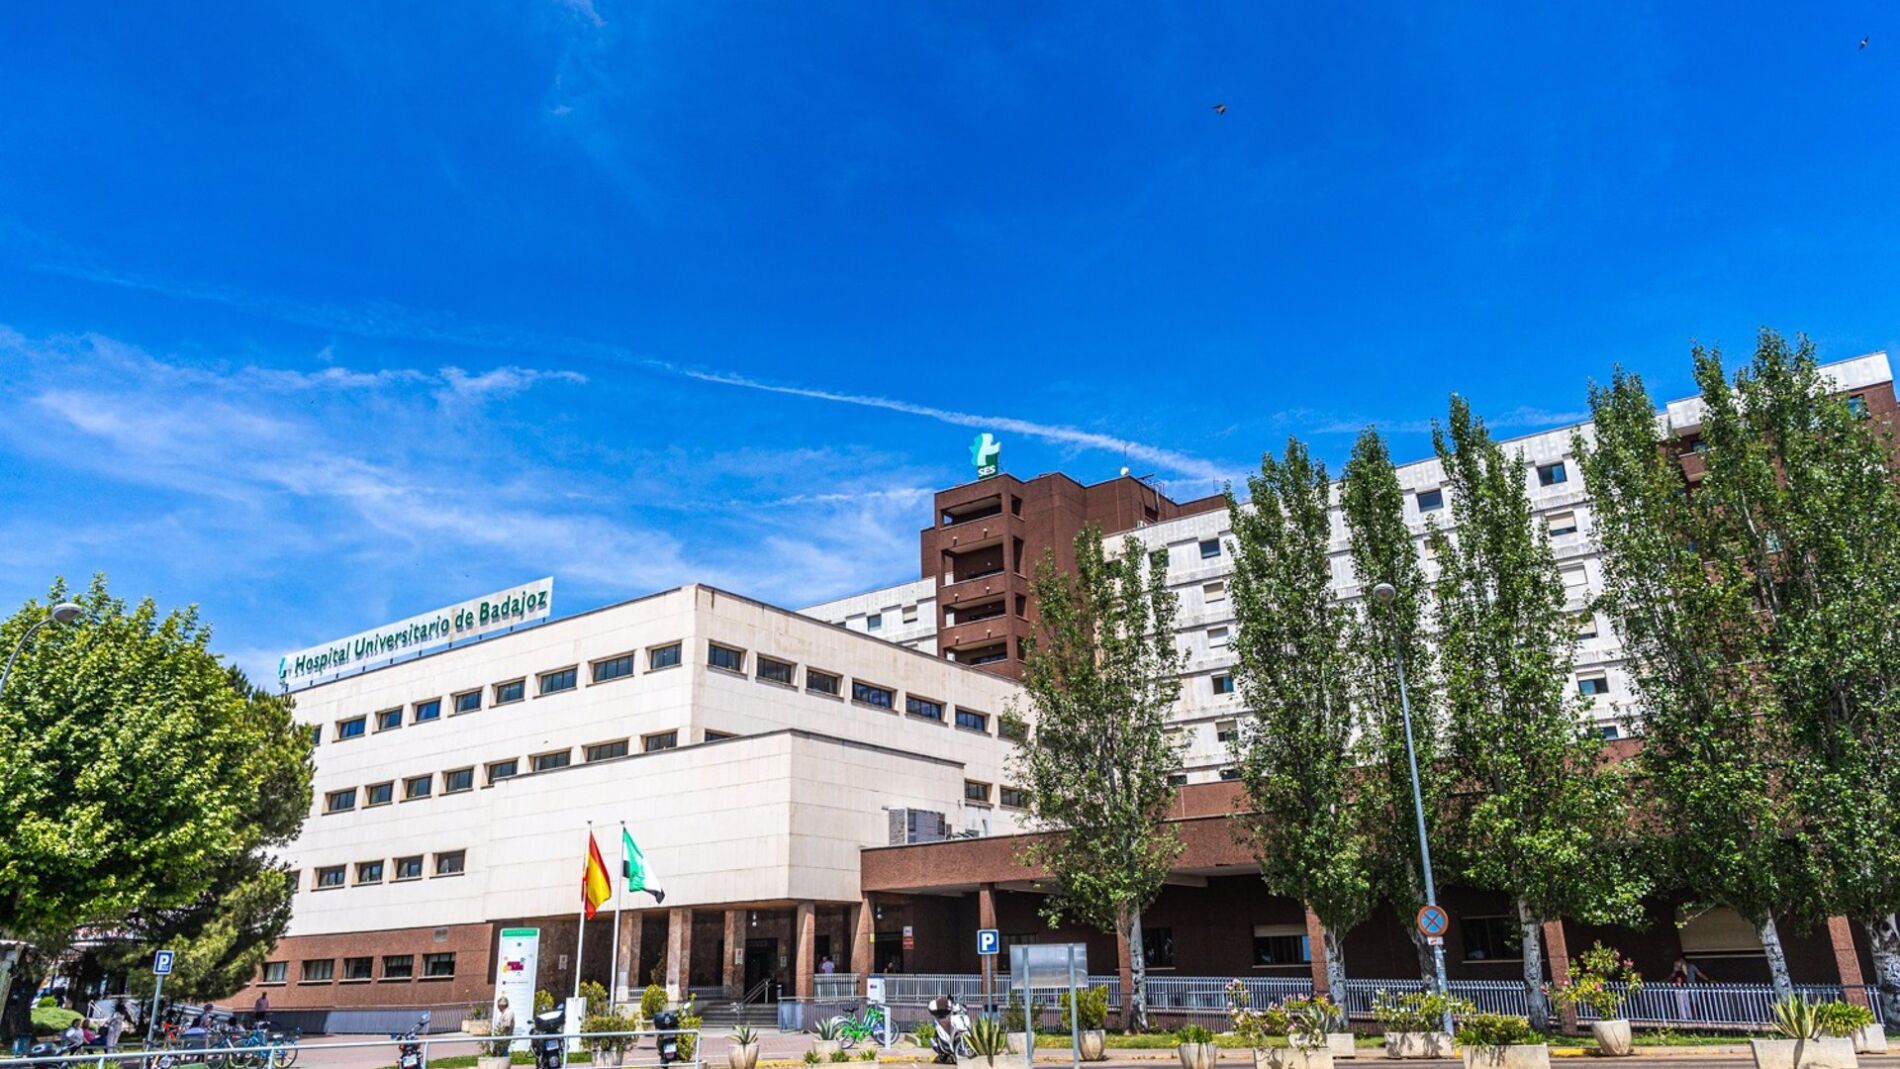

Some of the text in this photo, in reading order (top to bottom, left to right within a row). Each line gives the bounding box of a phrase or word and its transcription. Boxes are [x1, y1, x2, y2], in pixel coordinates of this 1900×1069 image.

[978, 465, 996, 477] SES
[294, 590, 548, 674] Hospital Universitario de Badajoz
[981, 933, 995, 951] P
[157, 954, 170, 971] P
